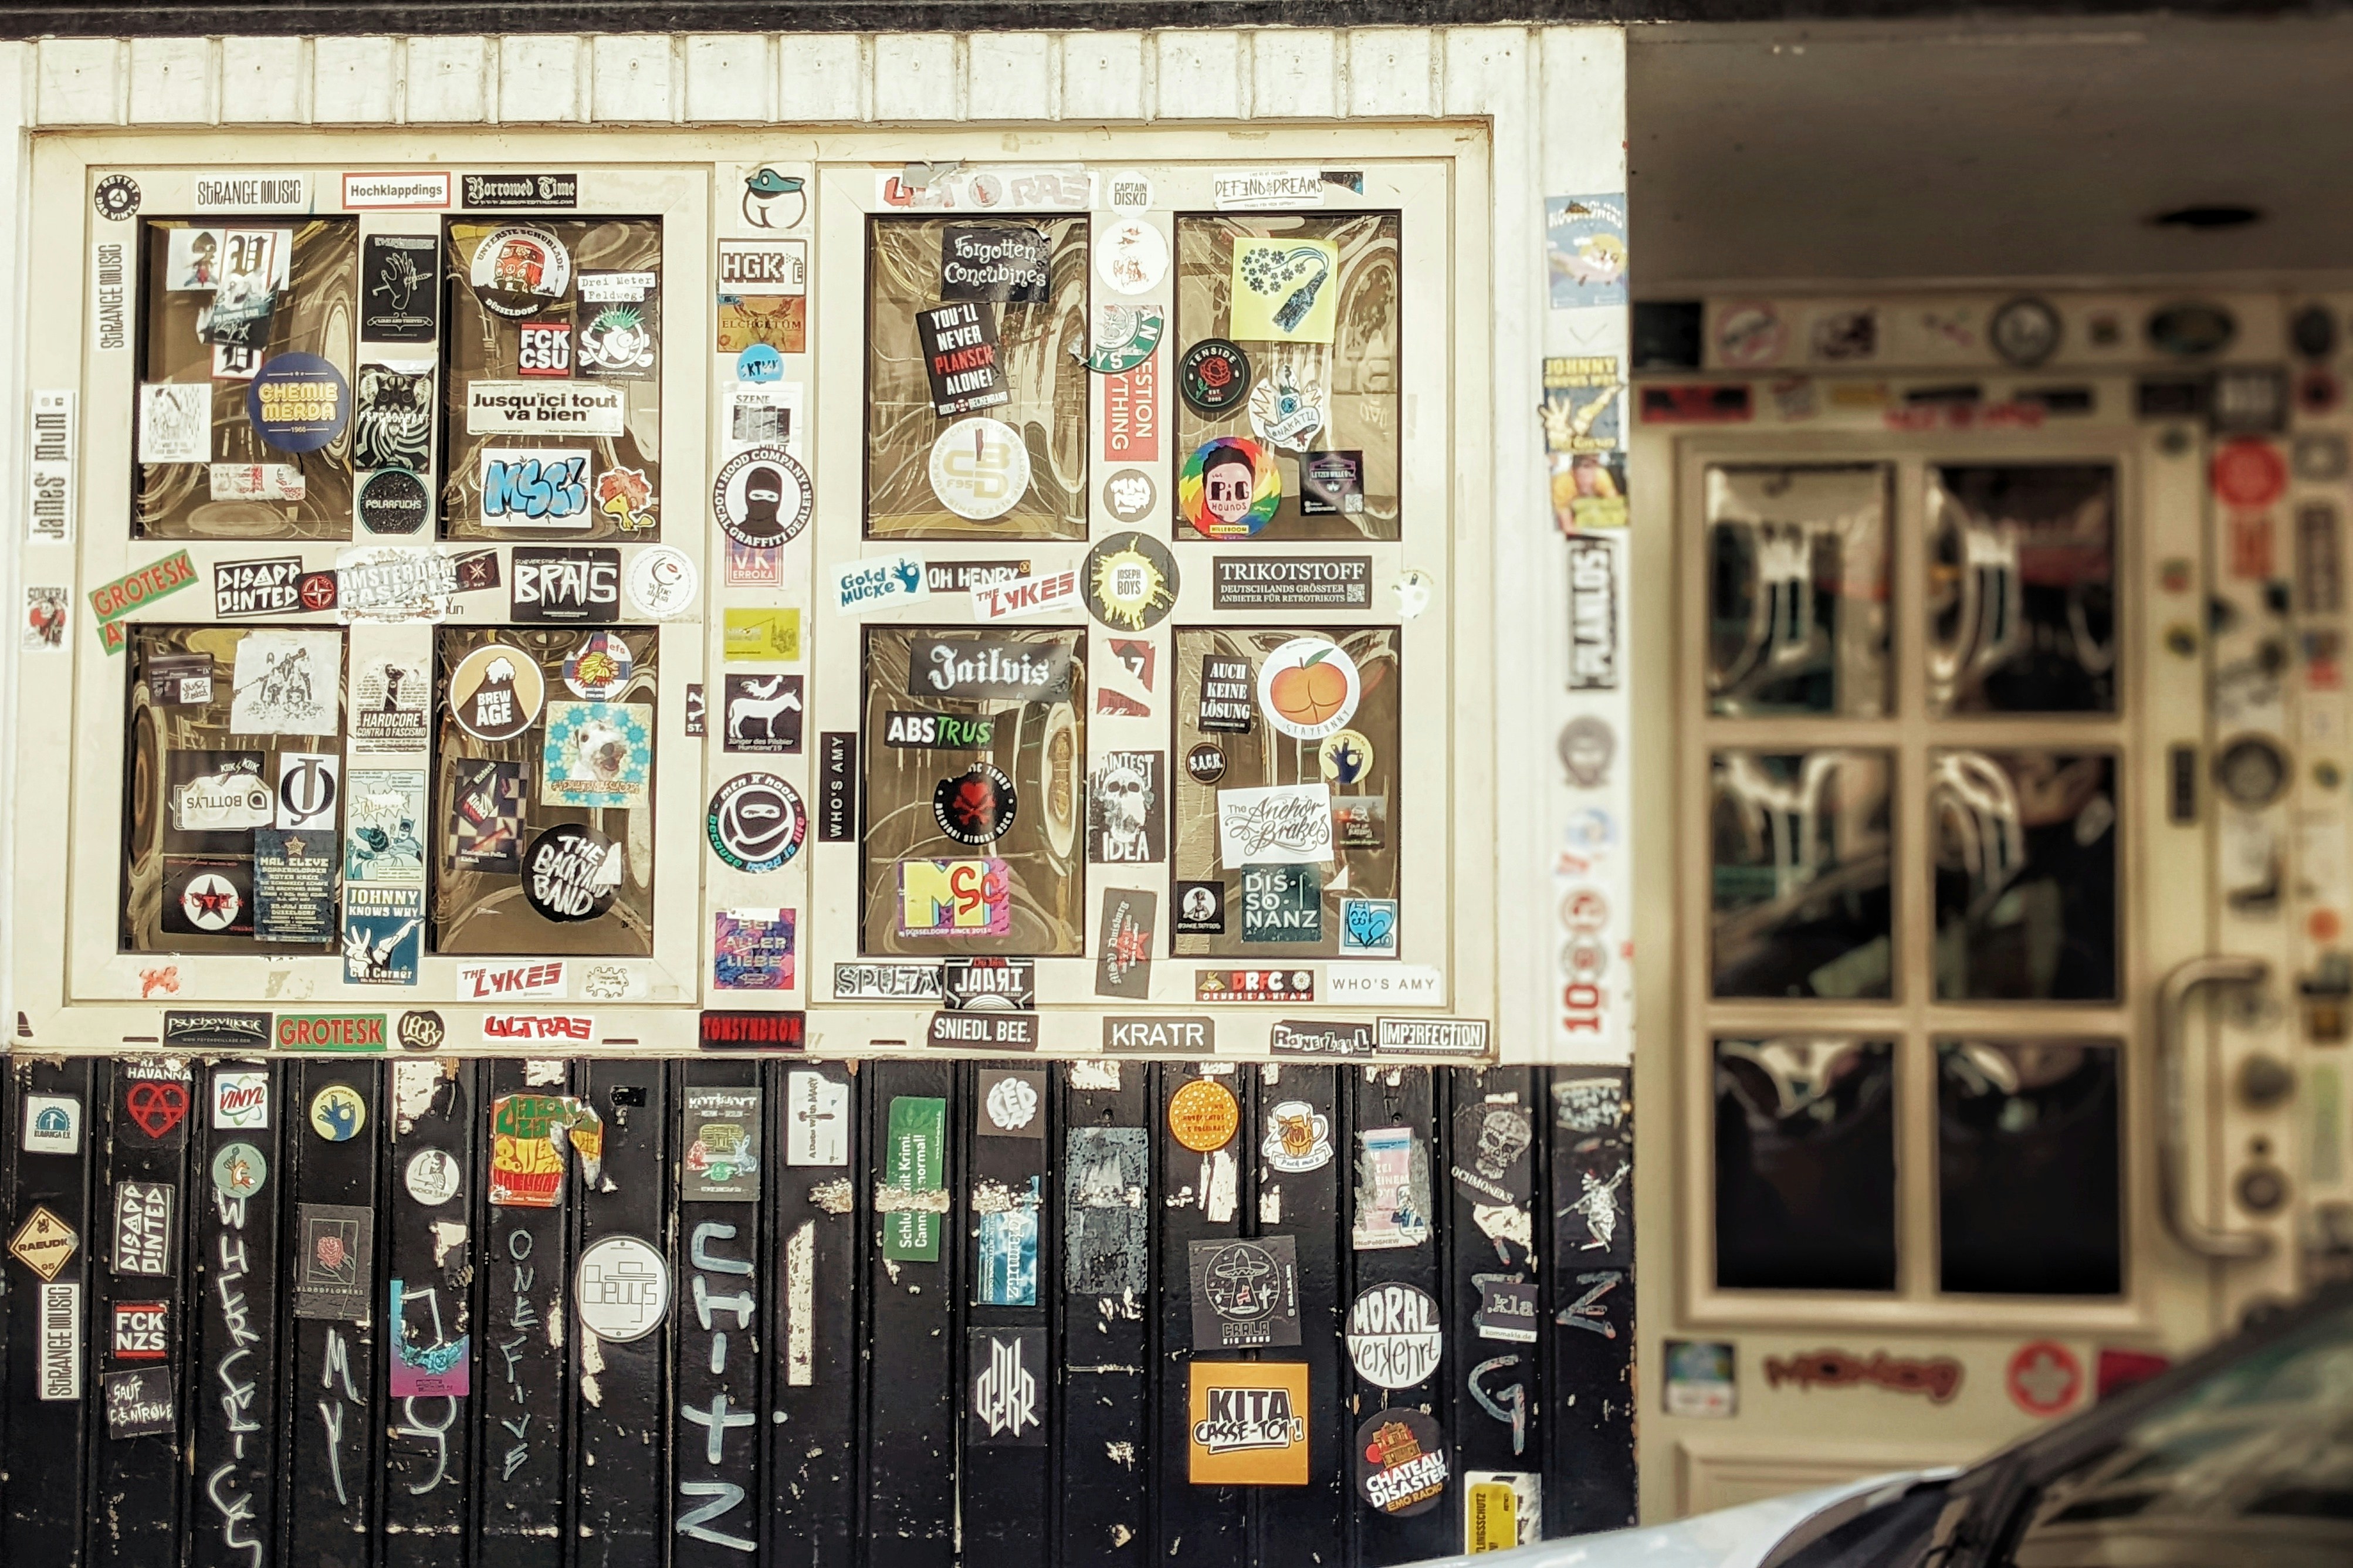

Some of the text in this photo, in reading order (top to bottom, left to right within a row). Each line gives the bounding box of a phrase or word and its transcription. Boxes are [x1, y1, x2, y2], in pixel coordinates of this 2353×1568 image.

[101, 175, 140, 194] RETTET
[351, 183, 443, 199] Hochklappdings
[466, 177, 575, 204] Borrowed Time
[1115, 182, 1147, 192] CAPTAIN
[95, 196, 139, 220] DAS VINYL
[1115, 192, 1147, 206] DISKO
[476, 228, 564, 272] UNTERSTE SCHUBLADE
[954, 235, 1037, 263] Forgotten
[722, 253, 784, 283] HGK
[944, 263, 1047, 287] Concubines
[581, 275, 652, 287] Drei Meter
[485, 297, 540, 317] DÜSSELDORF
[588, 289, 643, 302] Feldweg.
[521, 330, 570, 349] FCK
[937, 326, 982, 352] NEVER
[520, 350, 570, 370] CSU
[1190, 348, 1237, 368] TENSIDE
[258, 381, 339, 402] CHEMIE
[946, 368, 994, 395] ALONE!
[473, 392, 618, 409] Jusqu'ici tout
[736, 395, 770, 404] SZENE
[1135, 361, 1153, 438] ESTION
[262, 401, 337, 422] MERDA
[503, 408, 530, 421] va
[1111, 373, 1129, 451] YTHING
[719, 450, 810, 484] HOOD COMPANY
[365, 499, 422, 510] POLARFUCHS
[715, 489, 812, 547] LOCAL GRAFFITI DEALER
[339, 558, 457, 591] AMSTERDAM
[928, 566, 1020, 589] OH HENRY
[1220, 563, 1365, 581] TRIKOTSTOFF
[93, 554, 194, 617] GROTESK
[340, 577, 458, 606] CASUALS
[976, 571, 1075, 618] THE LYKES
[1117, 580, 1141, 595] BOYS
[1220, 583, 1345, 594] DEUTSCHLANDS GRÖSSTER
[1220, 593, 1345, 603] ANBIETER FÜR RETROTRIKOTS
[1209, 662, 1246, 680] AUCH
[477, 689, 512, 706] BREW
[1206, 682, 1247, 700] KEINE
[363, 712, 419, 728] HARDCORE
[476, 704, 512, 727] AGE
[1201, 697, 1250, 721] LÖSUNG
[357, 727, 384, 737] CONTRA
[392, 727, 426, 737] FASCISMO
[764, 775, 798, 803] hood
[830, 736, 844, 838] WHO'S AMY
[1227, 802, 1247, 815] The
[709, 814, 743, 868] because
[1102, 831, 1150, 862] IDEA
[1245, 814, 1330, 856] Brakes
[260, 857, 285, 866] MAL
[557, 835, 605, 865] THE
[350, 889, 419, 905] JOHNNY
[532, 873, 594, 916] BAND
[348, 906, 419, 917] KNOWS WHY
[1245, 910, 1319, 929] NANZ
[723, 936, 787, 949] ALLER
[462, 963, 562, 997] THE LYKES
[1232, 971, 1284, 991] DRFC
[1332, 978, 1434, 991] WHO'S AMY
[278, 1017, 384, 1045] GROTESK
[484, 1015, 593, 1041] ULTRAS
[933, 1018, 1031, 1044] SNIEDL BEE.
[1112, 1023, 1204, 1047] KRATR
[127, 1066, 193, 1081] HAVANNA
[220, 1086, 264, 1110] VINYL
[807, 1077, 818, 1103] MARY
[898, 1133, 912, 1171] Krimi.
[913, 1134, 927, 1184] normal!
[40, 1262, 56, 1271] 95
[1353, 1287, 1440, 1334] MORAL
[1487, 1293, 1533, 1317] .kla
[116, 1312, 166, 1331] FCK
[116, 1332, 165, 1350] NZS
[1209, 1391, 1291, 1424] KITA
[1366, 1449, 1444, 1491] CHATEAU
[1370, 1465, 1449, 1508] DISASTER
[1386, 1482, 1444, 1512] EMO RADIO
